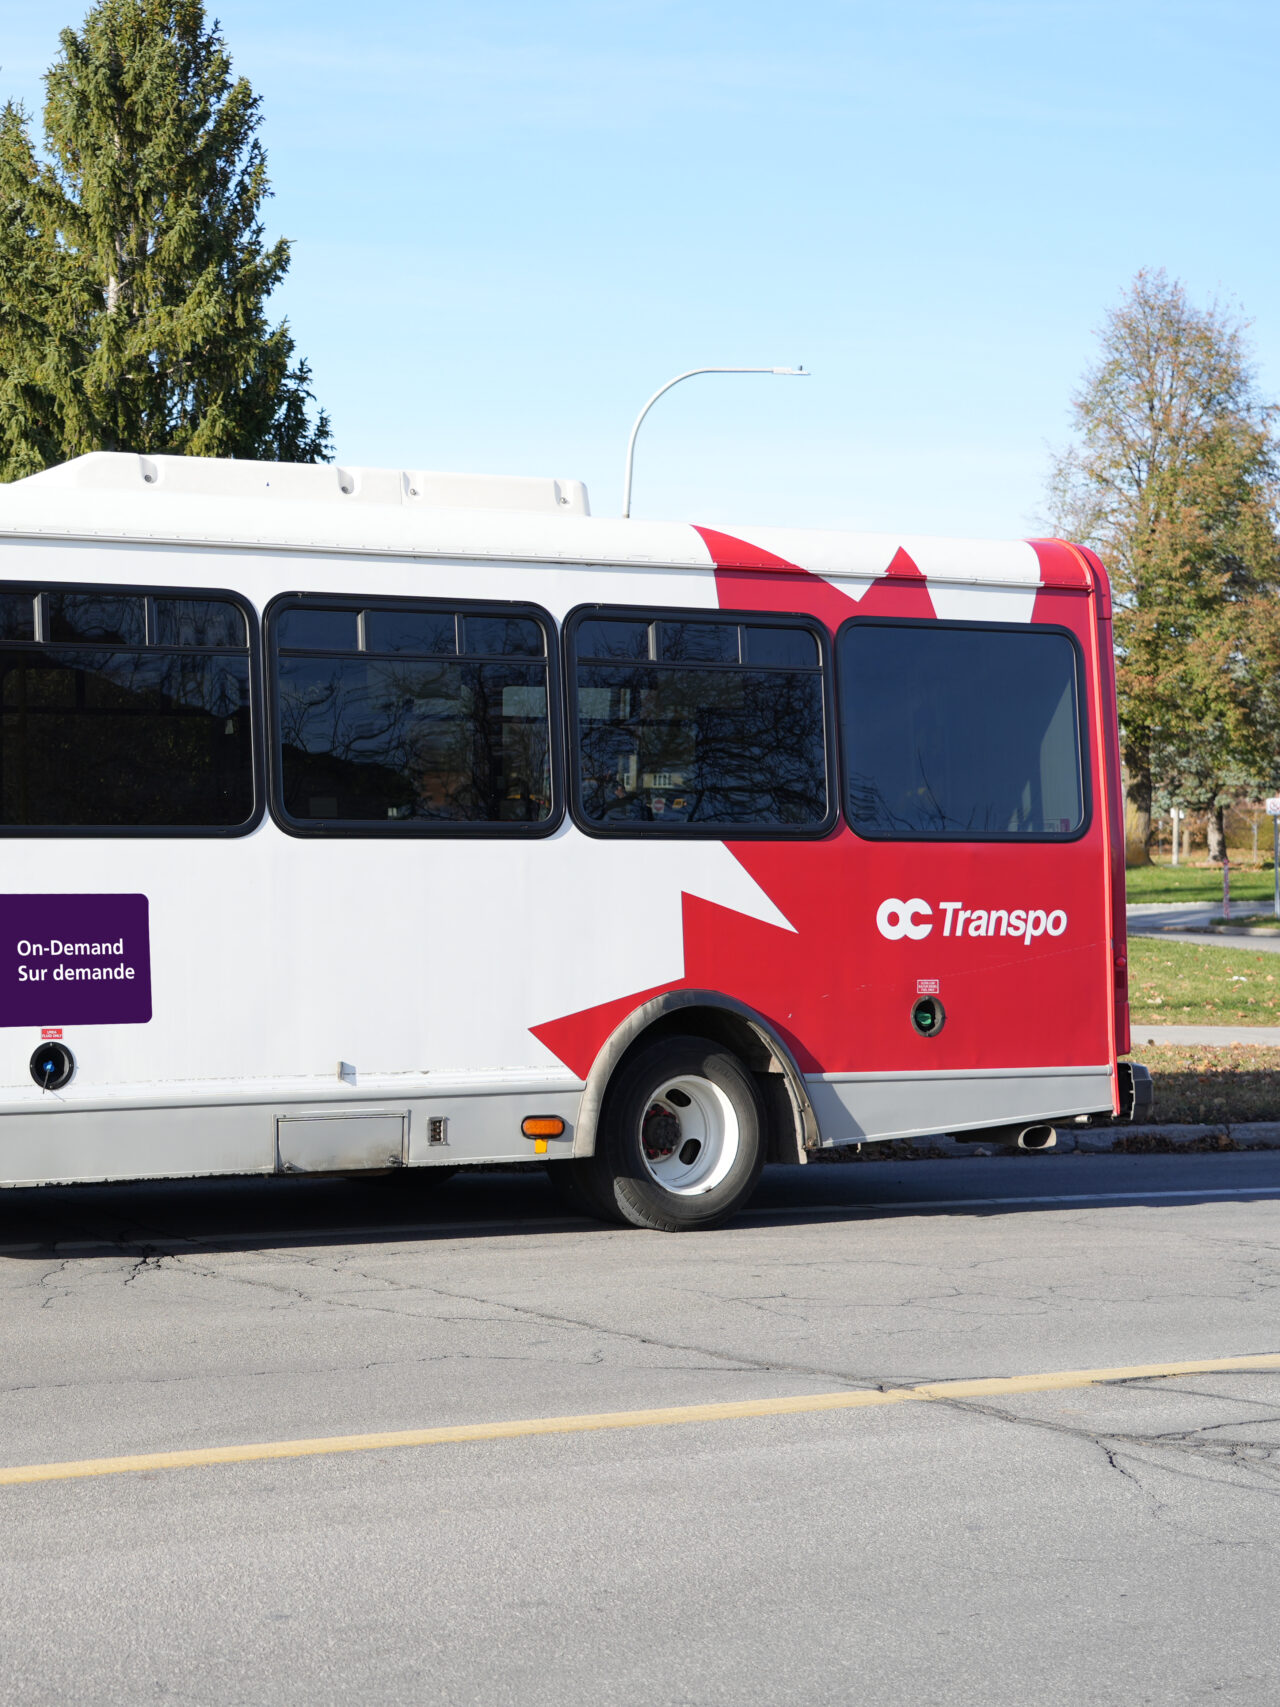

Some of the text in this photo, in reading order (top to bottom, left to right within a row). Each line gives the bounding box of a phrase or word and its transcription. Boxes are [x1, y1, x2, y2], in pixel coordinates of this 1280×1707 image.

[876, 897, 1068, 946] OC Transpo
[17, 938, 124, 956] On-Demand
[18, 962, 136, 982] Sur demande
